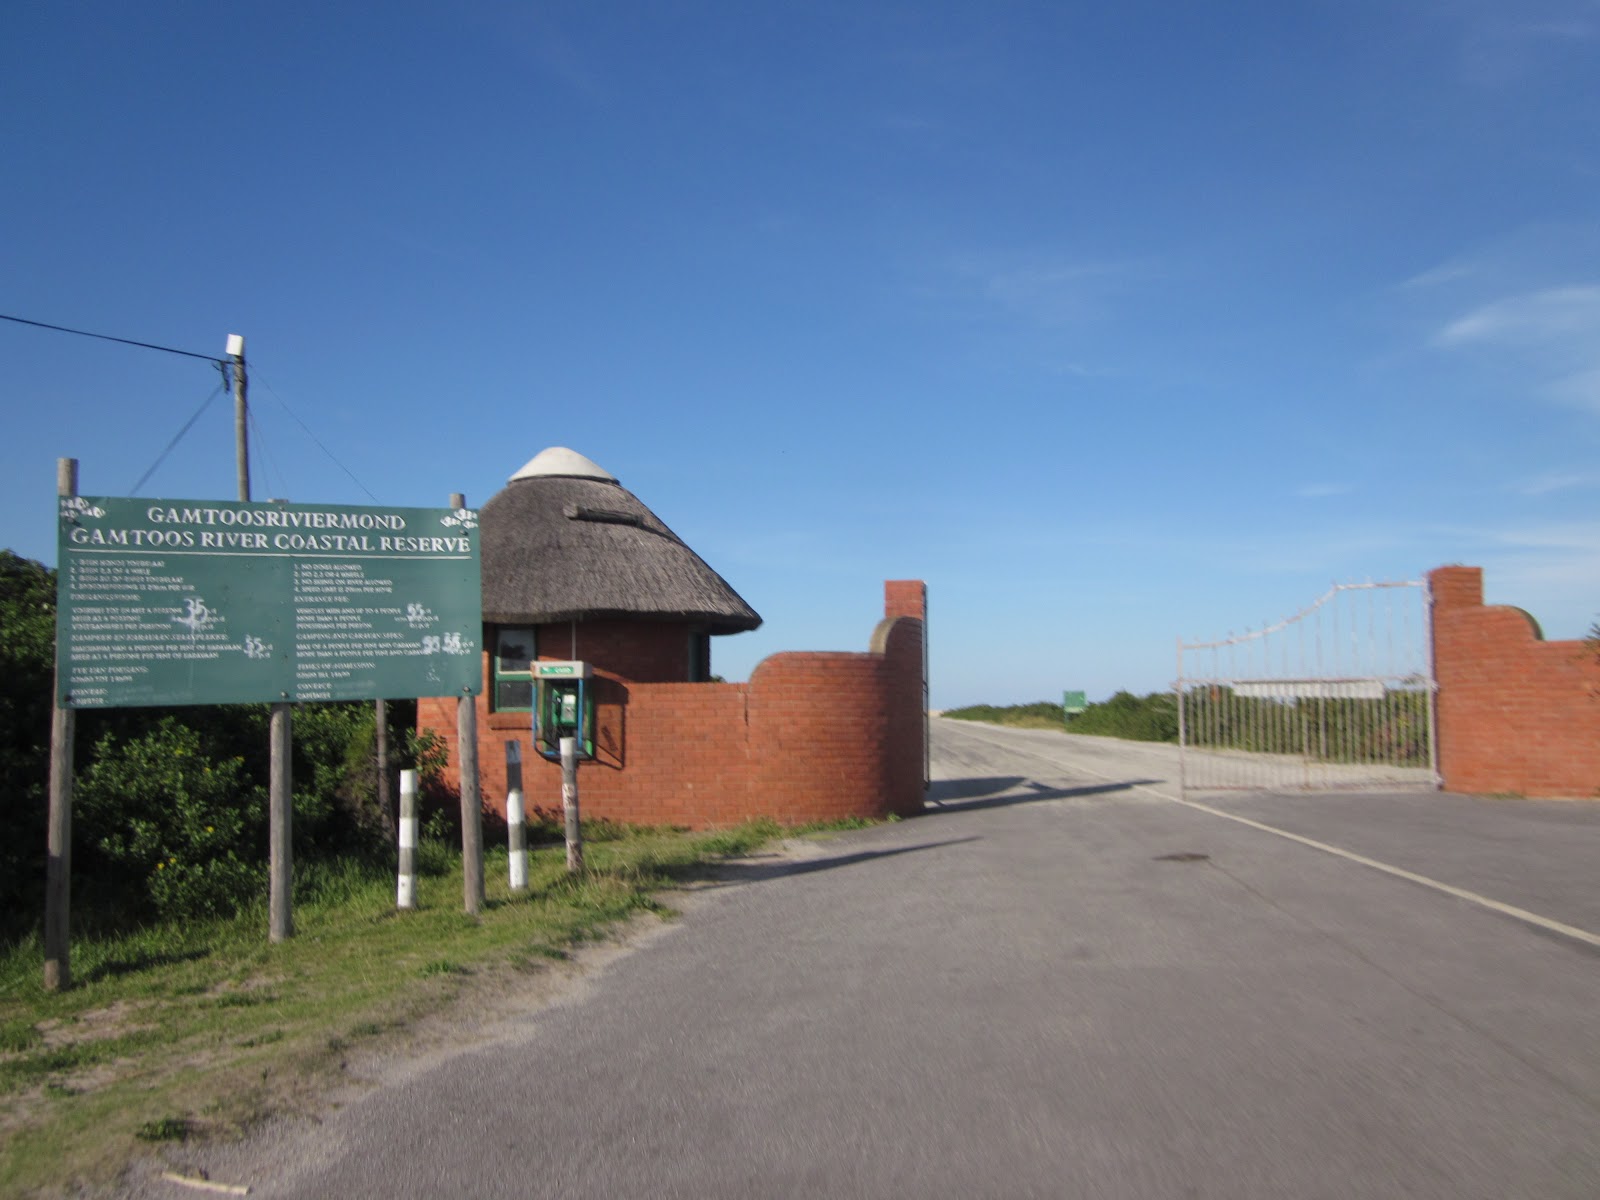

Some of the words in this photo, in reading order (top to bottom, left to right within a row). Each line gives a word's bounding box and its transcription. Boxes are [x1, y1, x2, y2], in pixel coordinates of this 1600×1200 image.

[147, 506, 407, 530] GAMTOOSRIVIERMOND
[70, 527, 195, 547] GAMTOOS
[200, 531, 269, 549] RIVER
[274, 533, 375, 551] COASTAL
[380, 536, 471, 553] RESERVE
